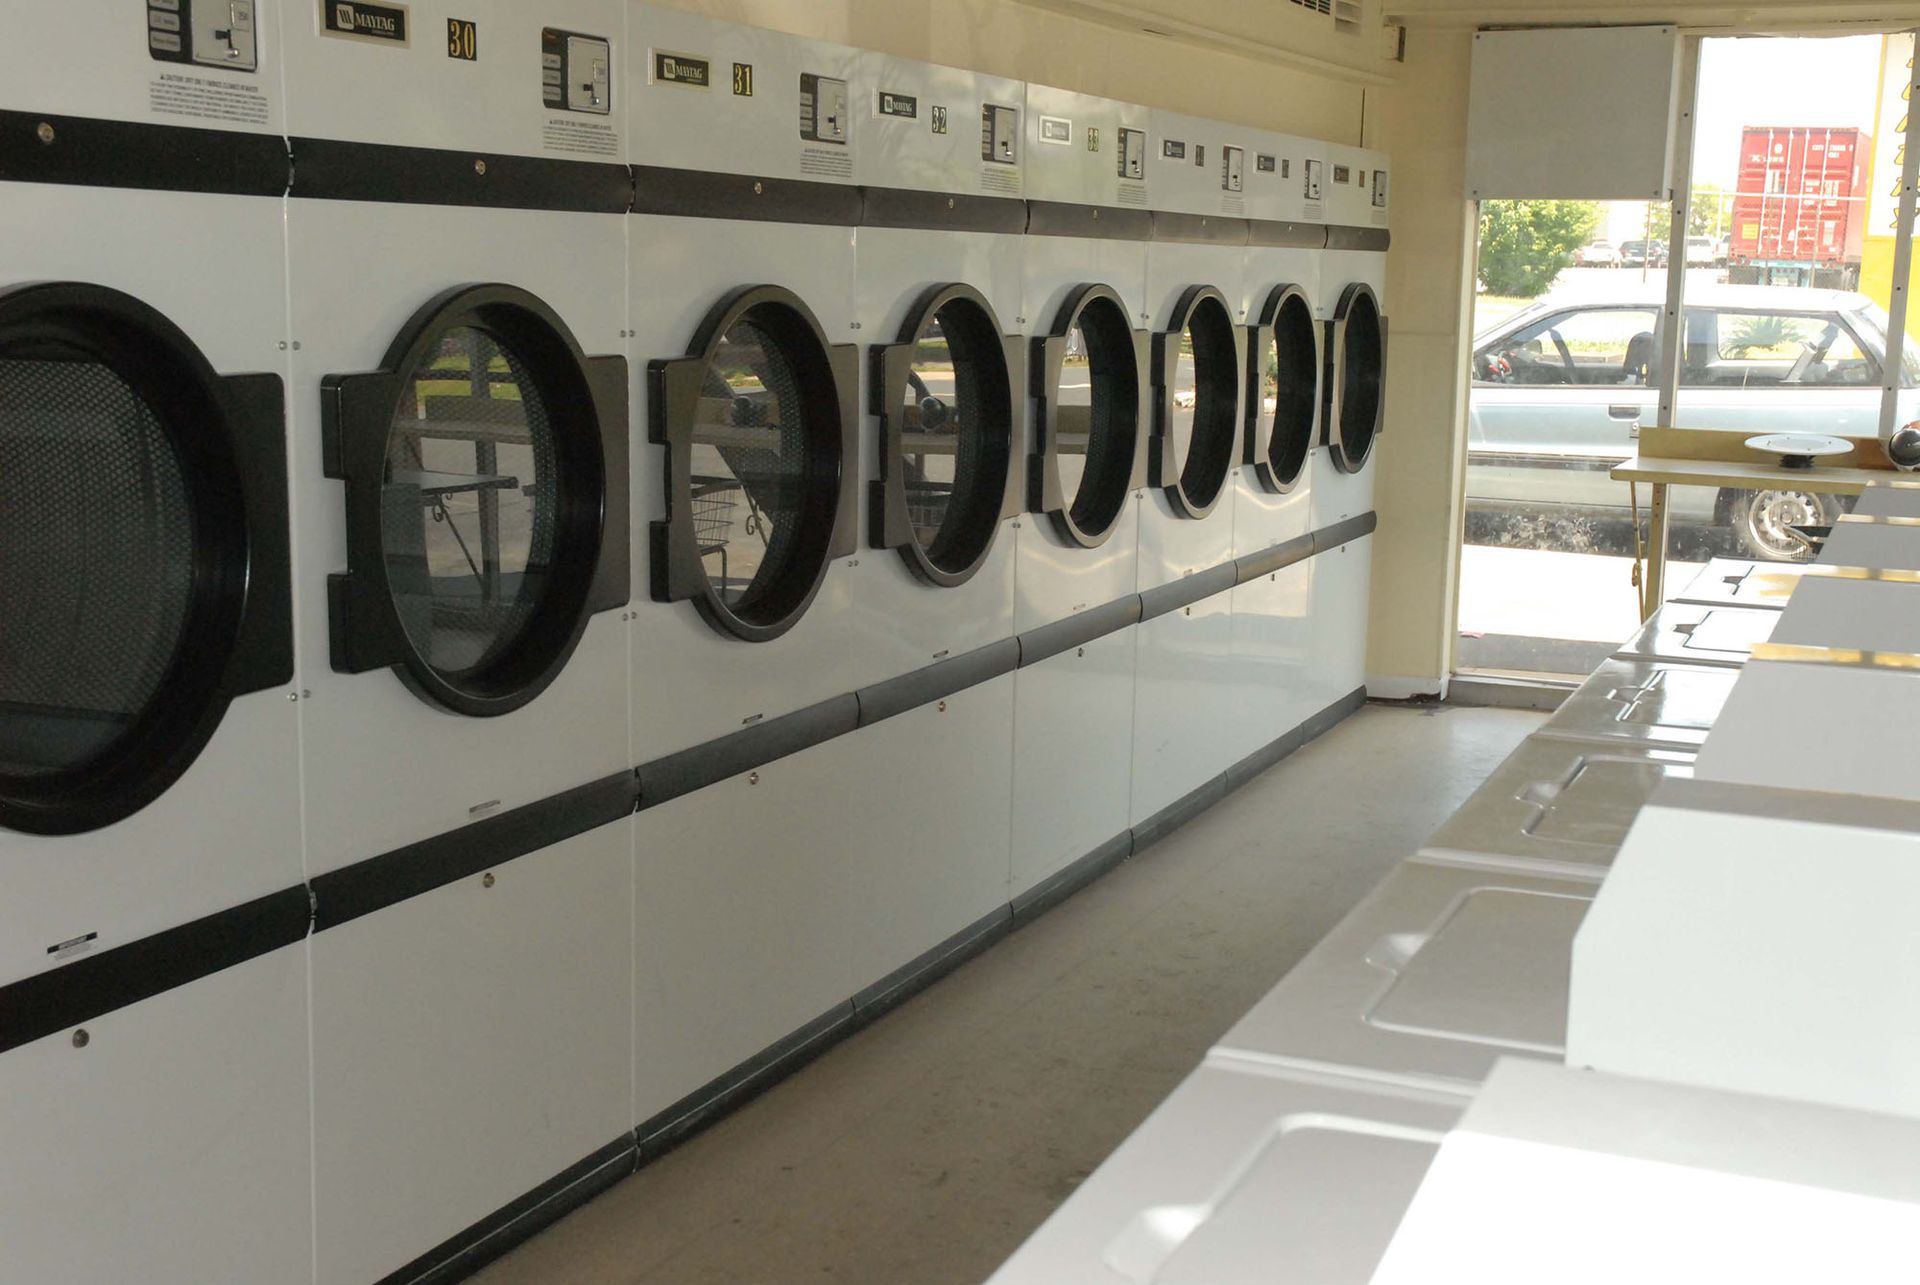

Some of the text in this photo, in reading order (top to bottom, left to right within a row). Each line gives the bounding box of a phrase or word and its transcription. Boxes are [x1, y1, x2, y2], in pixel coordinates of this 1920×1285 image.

[354, 12, 395, 32] MAYTAG
[450, 20, 475, 59] 30
[675, 63, 703, 79] MAYTAG
[735, 64, 752, 95] 31
[933, 106, 946, 133] 32
